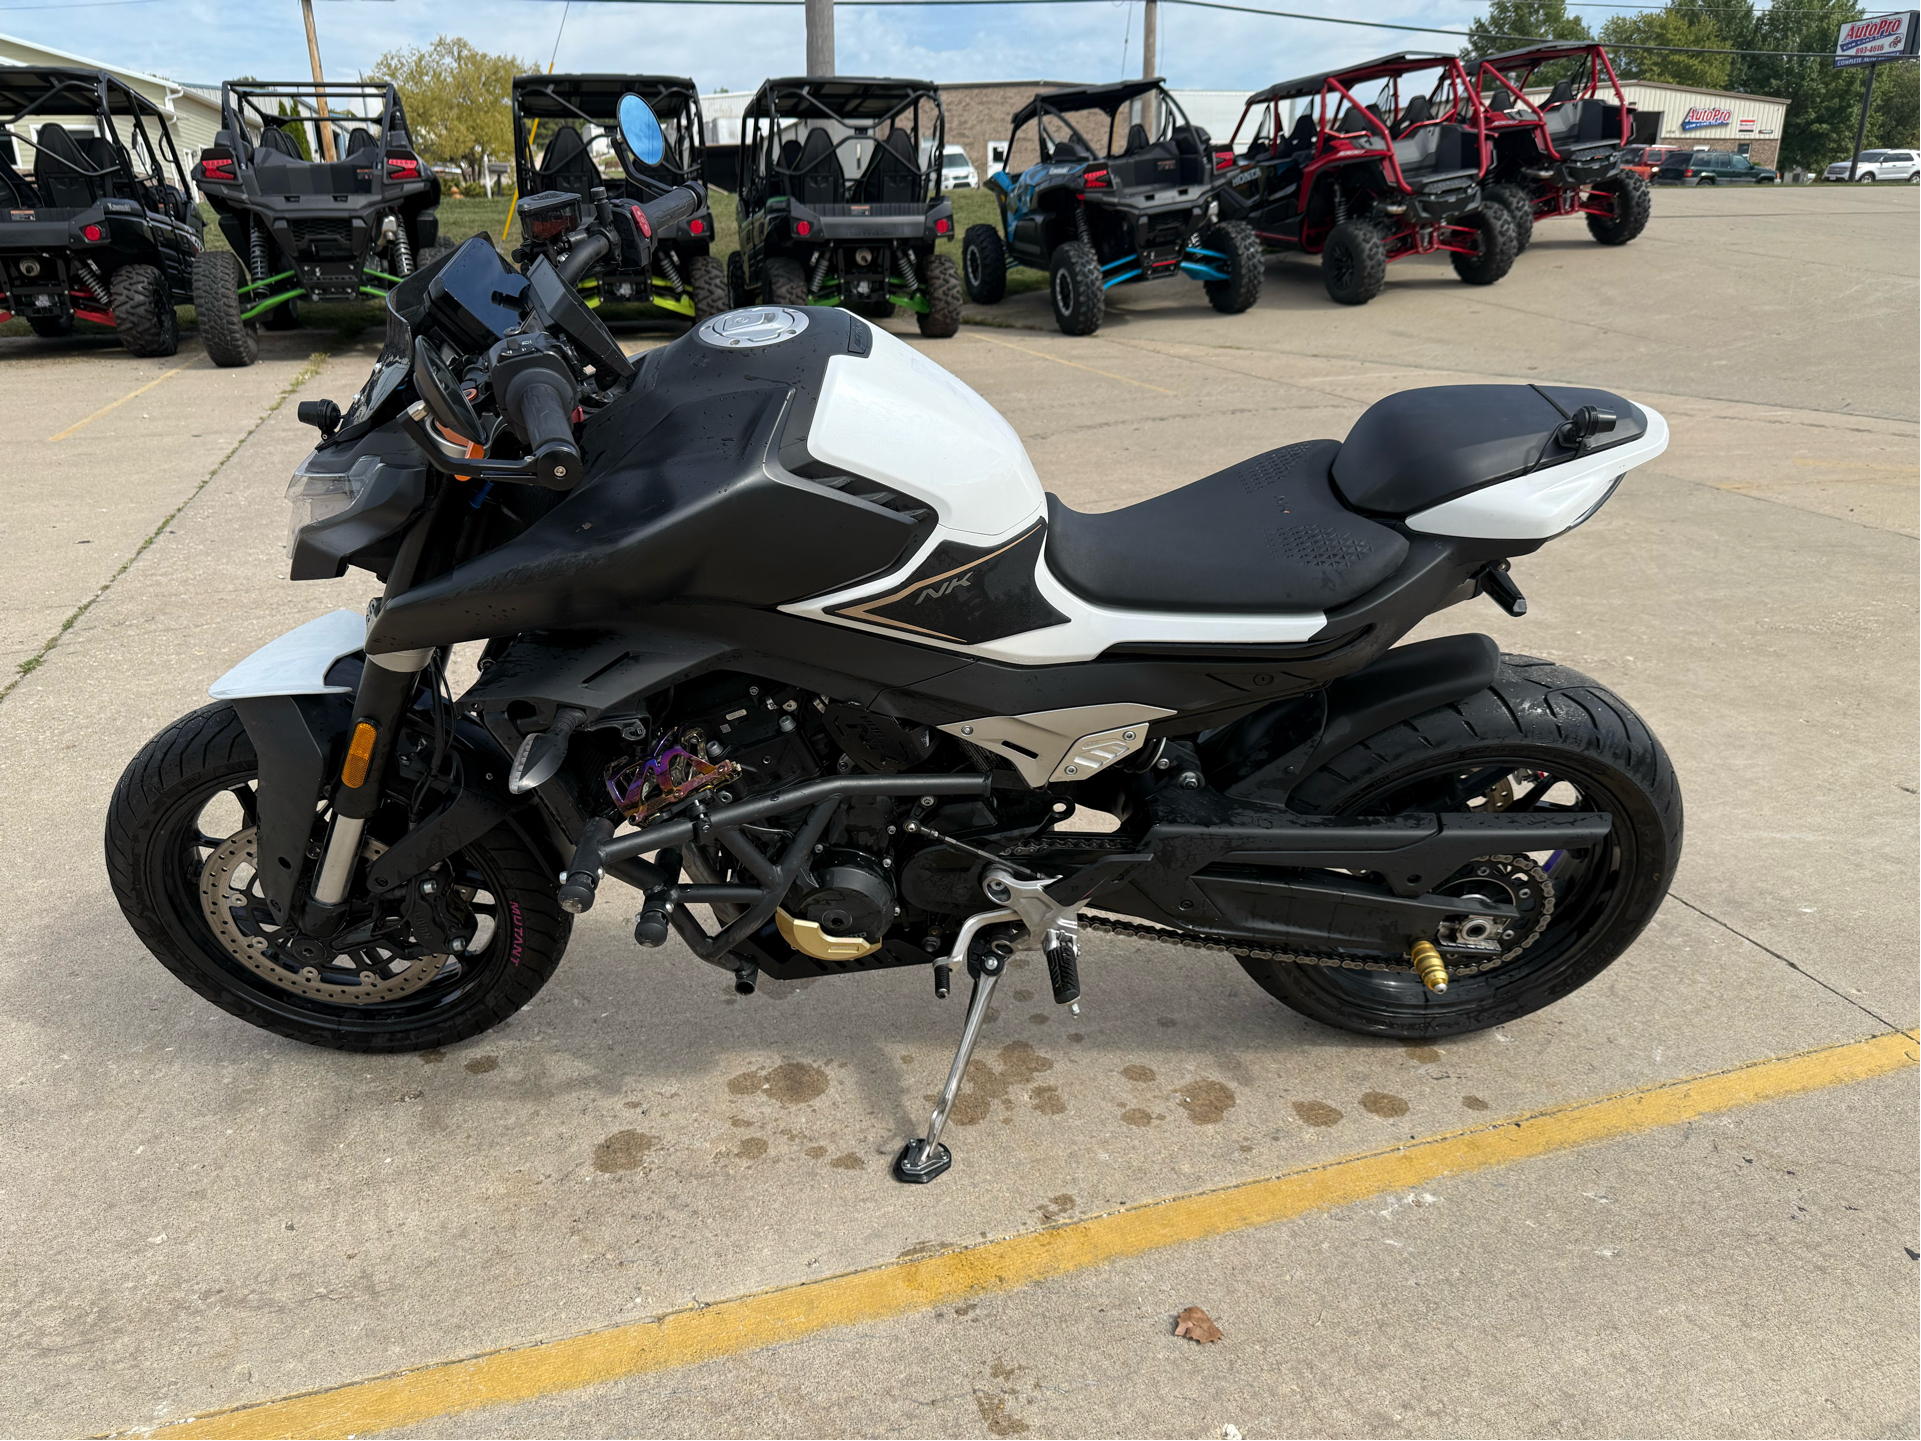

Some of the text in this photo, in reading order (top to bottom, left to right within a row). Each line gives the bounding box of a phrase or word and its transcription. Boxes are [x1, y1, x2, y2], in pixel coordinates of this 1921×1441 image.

[1842, 17, 1902, 42] AutoPro
[1843, 42, 1856, 50] CAR
[1855, 43, 1885, 55] 893-4616
[1685, 107, 1732, 122] AutoPro
[1232, 167, 1262, 188] HONDA
[107, 202, 131, 212] Kawasaki
[914, 571, 974, 605] NK
[509, 901, 523, 967] MUTANT
